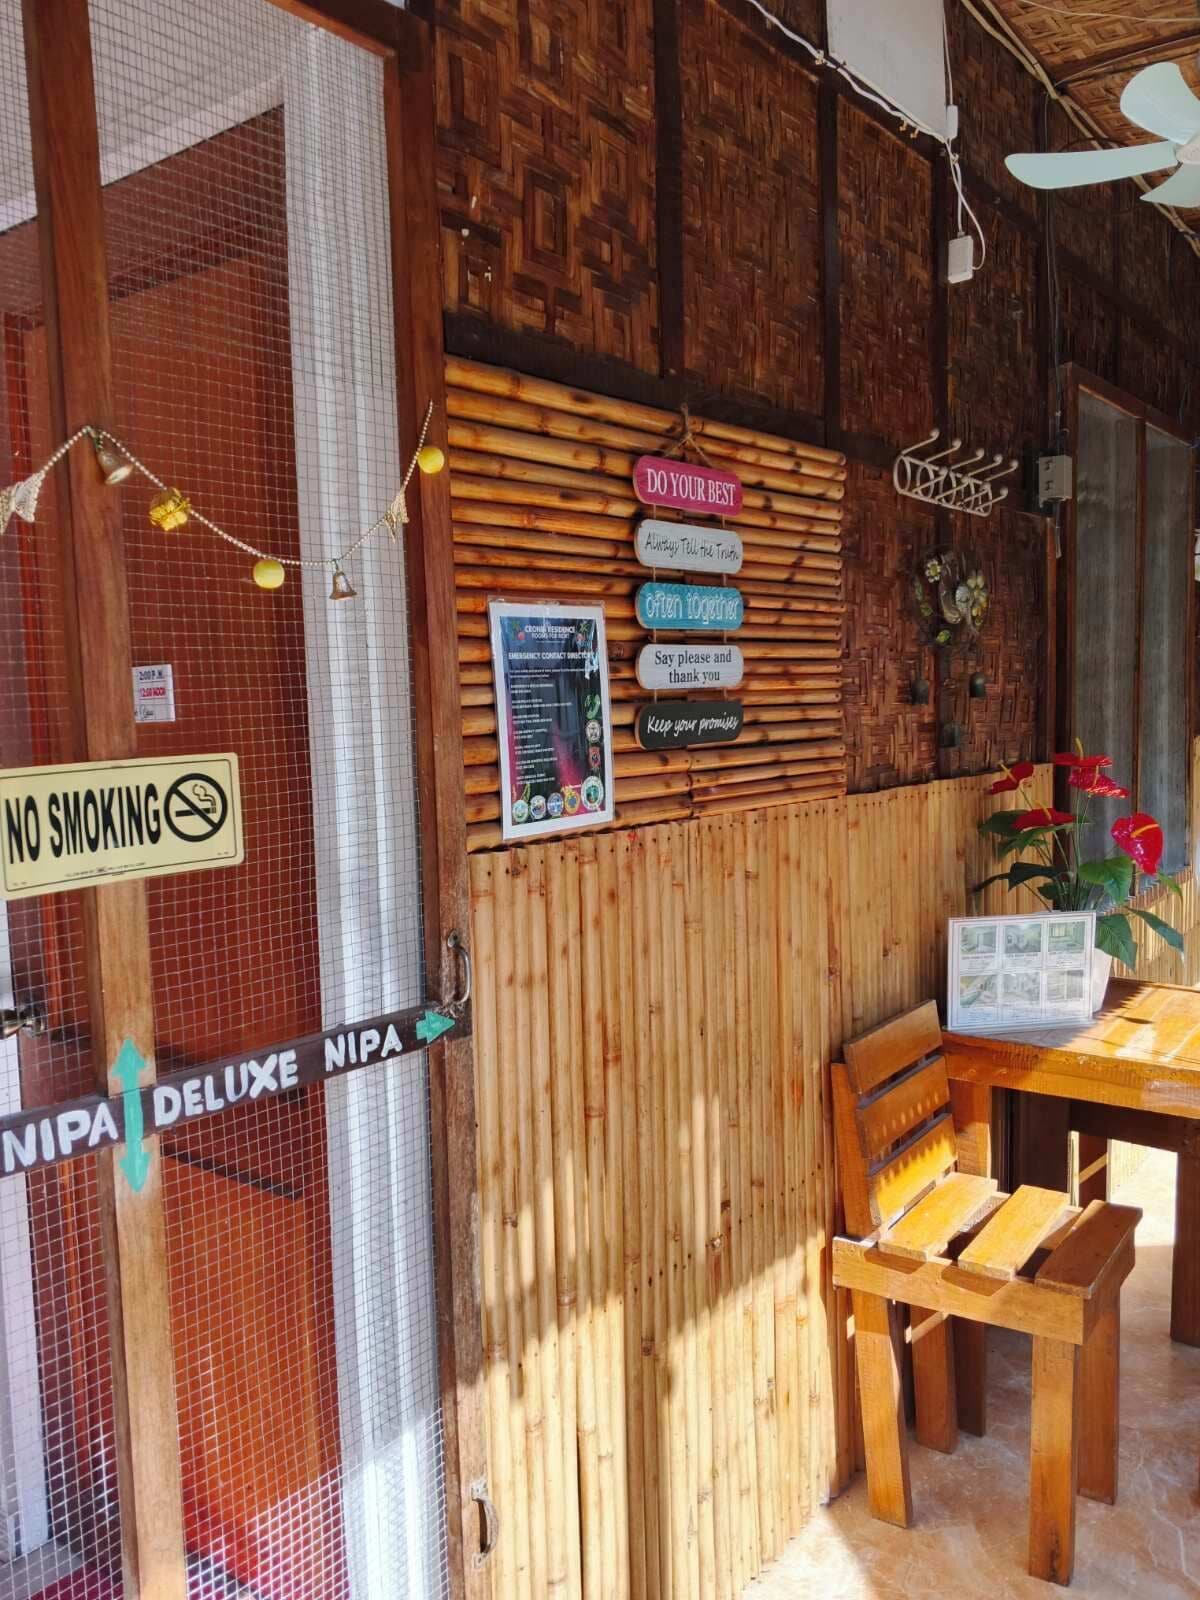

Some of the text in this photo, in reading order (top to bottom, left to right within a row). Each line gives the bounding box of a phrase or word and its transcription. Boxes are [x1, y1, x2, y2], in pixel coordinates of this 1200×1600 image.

[646, 468, 736, 506] DO YOUR BEST
[645, 531, 679, 558] Always
[680, 537, 699, 555] Tell
[700, 539, 713, 557] the
[687, 592, 739, 624] together
[547, 625, 576, 633] RESIDENCE
[508, 651, 541, 660] EMERGENCY
[541, 651, 566, 659] CONTACT
[655, 649, 732, 667] Say please and
[669, 668, 720, 684] thank you
[647, 711, 739, 737] Keep your promises
[5, 783, 162, 864] NO SMOKING
[324, 1023, 403, 1072] NIPA
[2, 1050, 298, 1172] NIPA DELUXE
